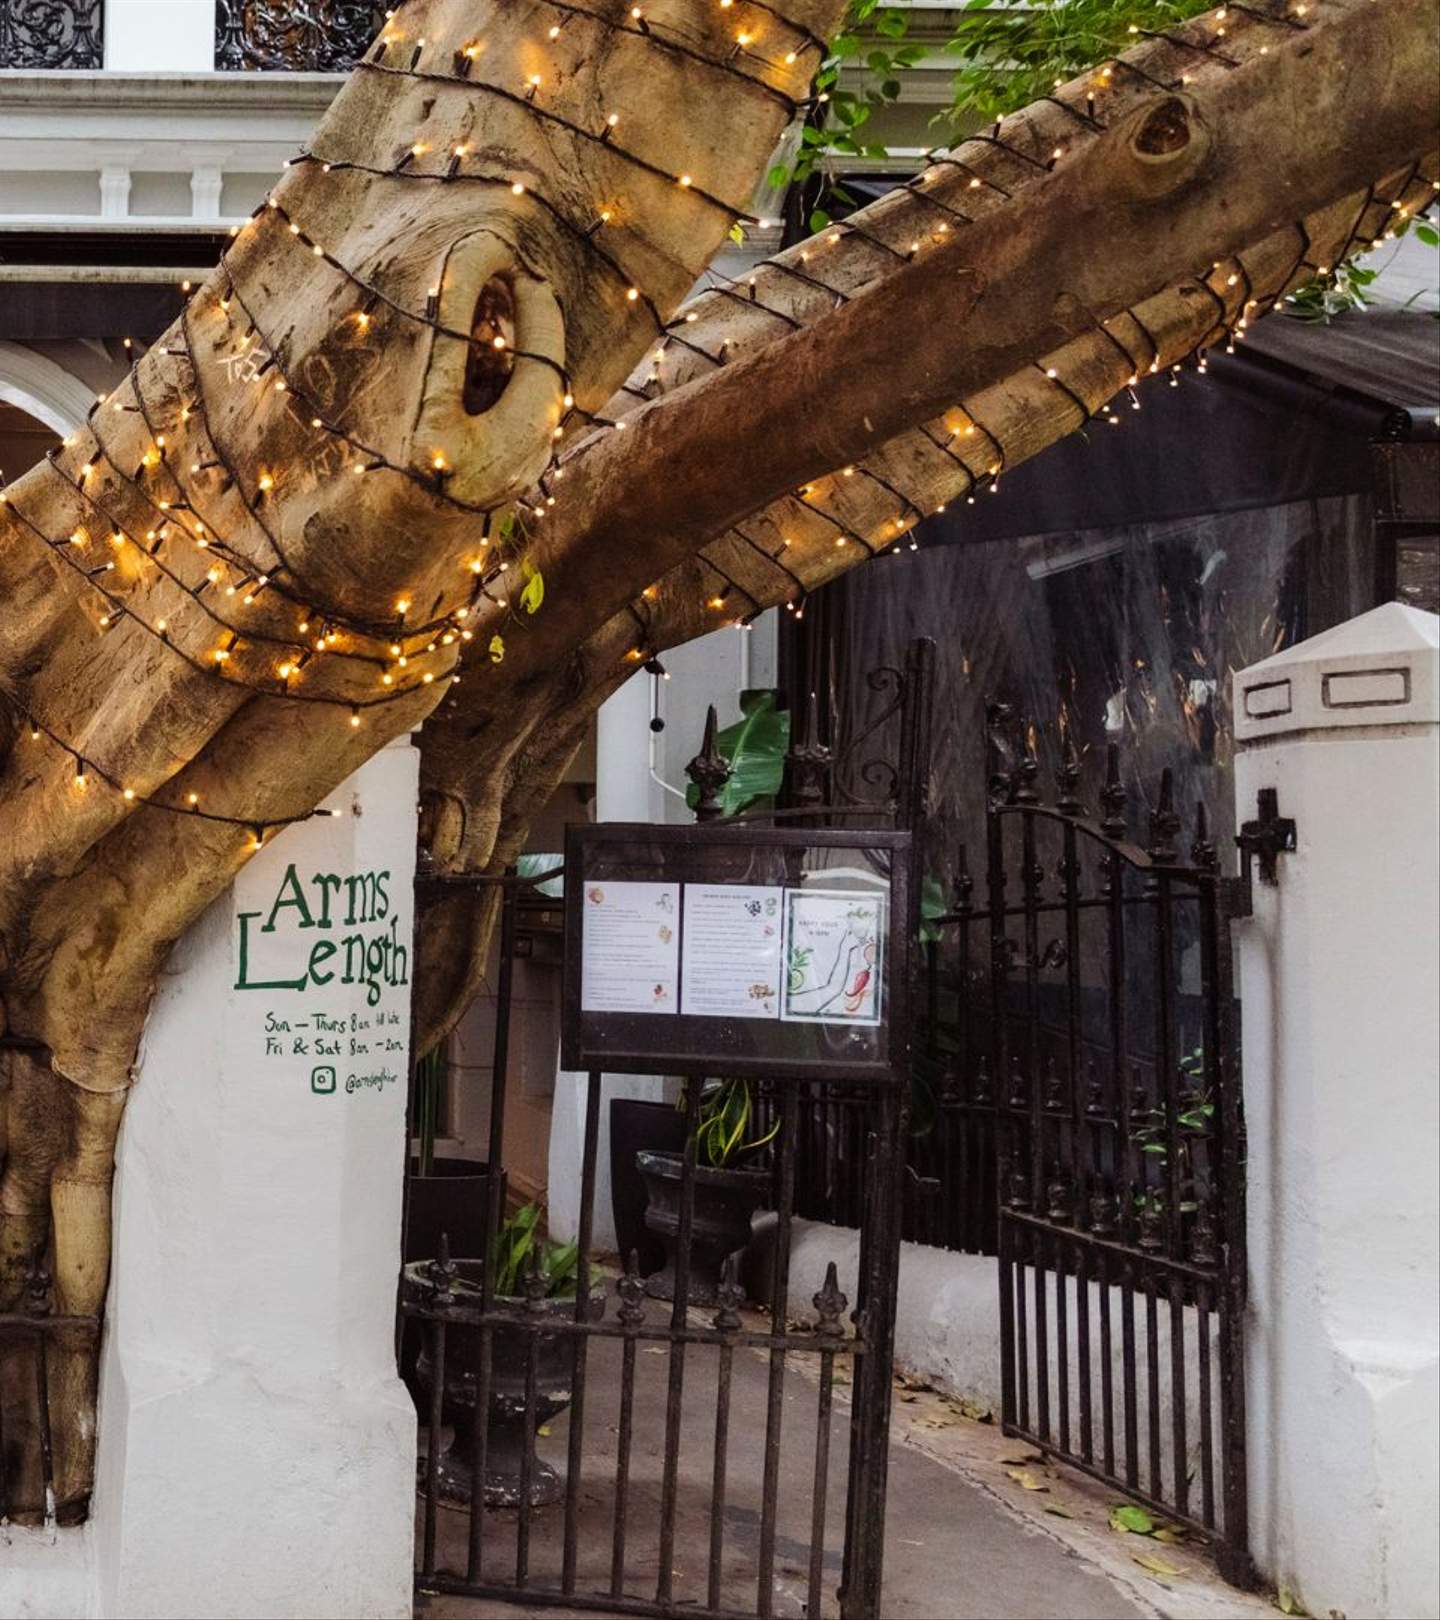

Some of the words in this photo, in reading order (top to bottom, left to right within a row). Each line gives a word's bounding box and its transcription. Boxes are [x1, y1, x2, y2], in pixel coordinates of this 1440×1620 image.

[261, 864, 390, 932] Arms
[234, 911, 408, 1006] Length
[264, 1011, 291, 1033] Sun
[311, 1013, 346, 1034] Thurs
[265, 1037, 283, 1056] Fri
[293, 1037, 309, 1055] &
[316, 1038, 342, 1055] Sat
